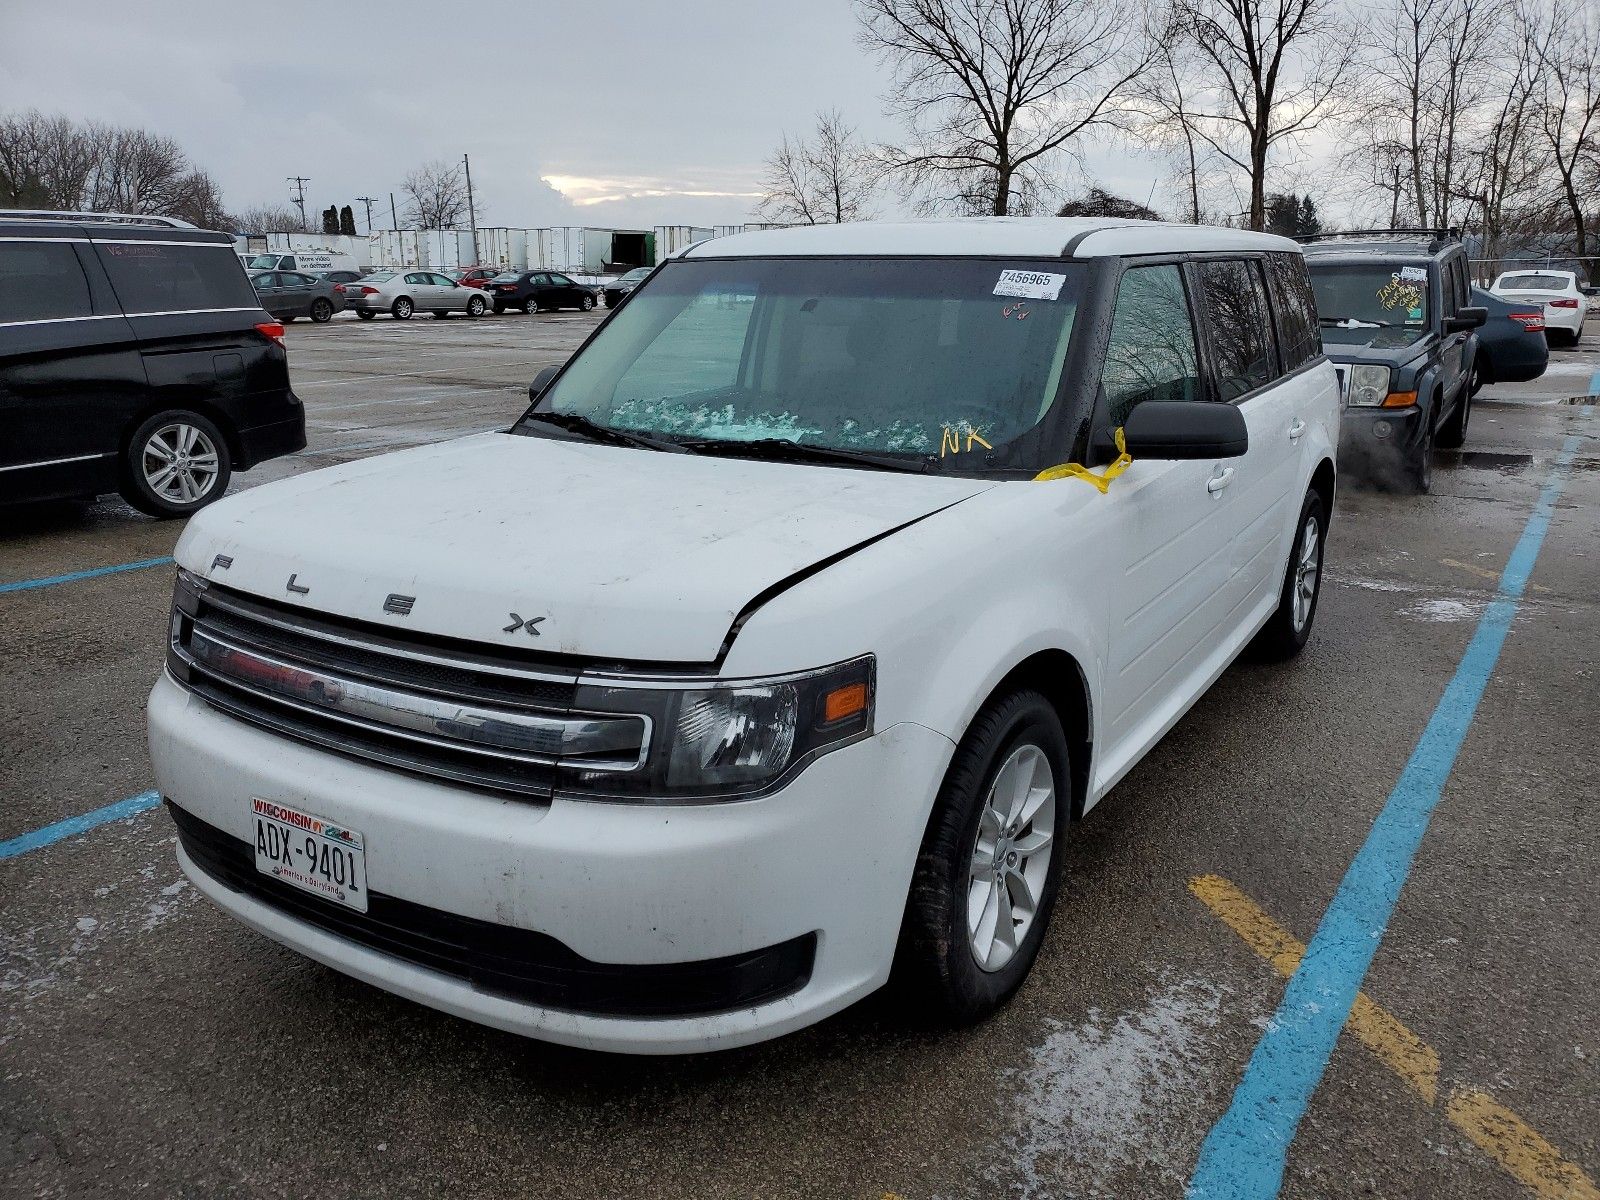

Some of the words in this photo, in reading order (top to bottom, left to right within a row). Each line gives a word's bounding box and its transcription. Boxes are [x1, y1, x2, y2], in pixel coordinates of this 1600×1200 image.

[1002, 272, 1051, 286] 7456965
[941, 425, 993, 458] NK
[211, 553, 546, 636] FLEX
[253, 798, 312, 830] WISCONSIN
[257, 819, 359, 892] ADX-9401
[309, 877, 340, 894] Dairyland
